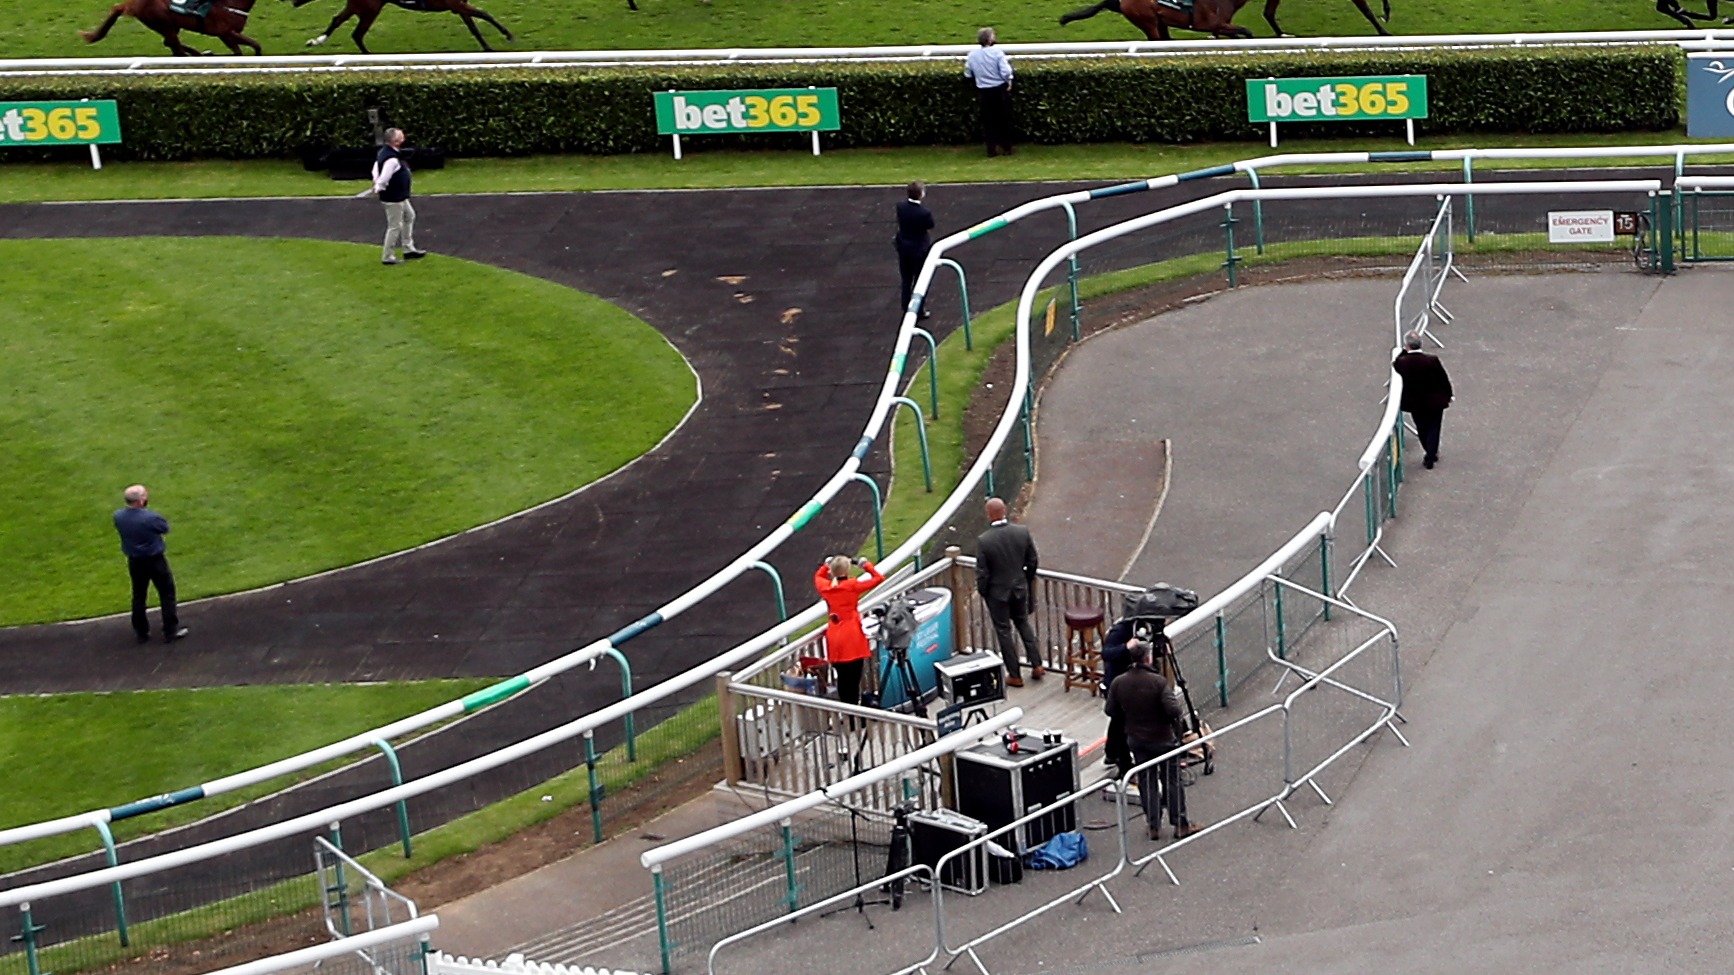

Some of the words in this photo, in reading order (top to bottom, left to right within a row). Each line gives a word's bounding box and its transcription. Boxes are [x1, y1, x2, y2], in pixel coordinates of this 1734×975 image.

[673, 95, 821, 129] bet365
[1266, 82, 1410, 117] bet365
[0, 108, 101, 141] t365
[1552, 215, 1609, 226] EMERGENCY
[1569, 227, 1592, 235] GATE
